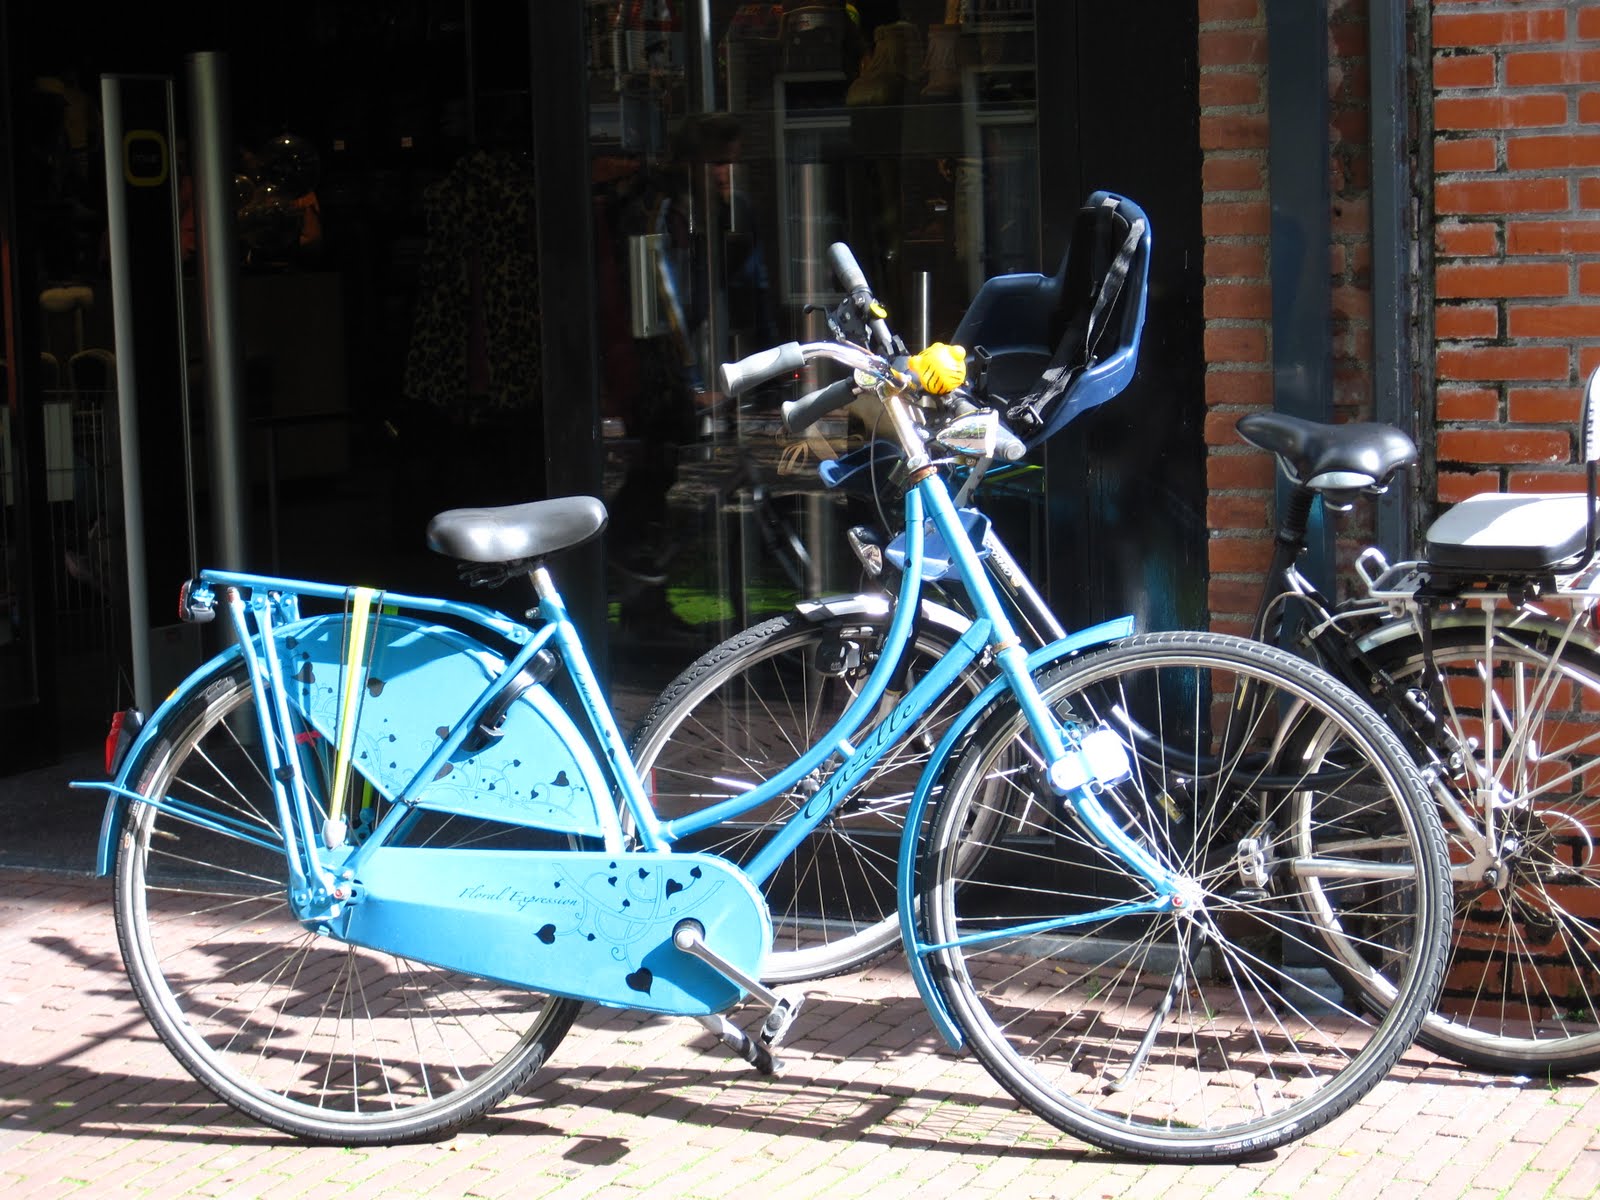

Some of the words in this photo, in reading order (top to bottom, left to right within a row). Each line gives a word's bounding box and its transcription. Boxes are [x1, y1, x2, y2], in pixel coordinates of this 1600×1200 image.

[804, 701, 918, 819] Gazelle
[458, 884, 512, 900] Floral
[509, 891, 578, 911] Expression
